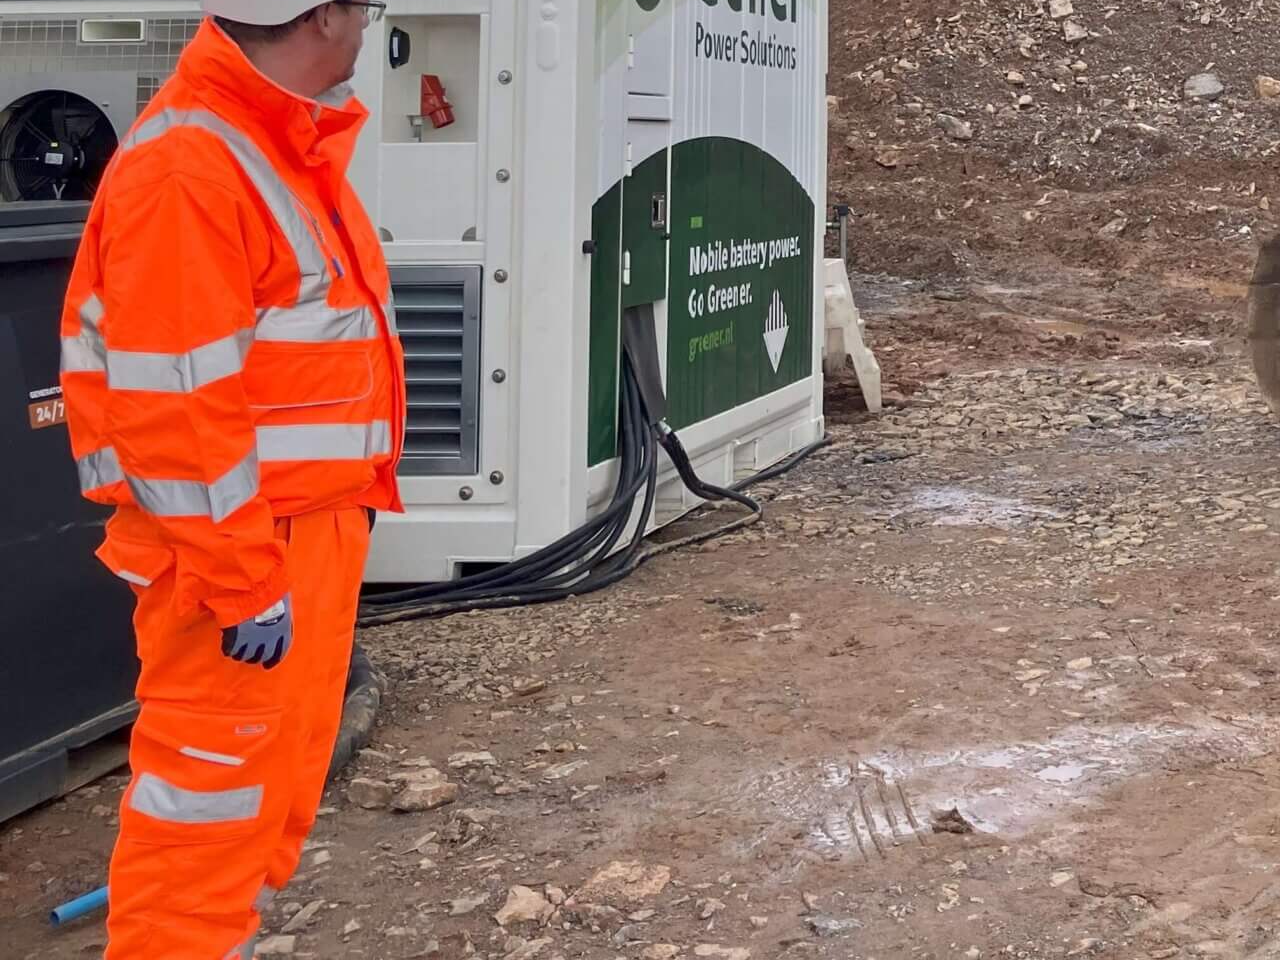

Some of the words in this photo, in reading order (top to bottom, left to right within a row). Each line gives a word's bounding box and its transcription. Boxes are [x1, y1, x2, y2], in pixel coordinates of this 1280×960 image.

[695, 21, 739, 63] Power
[740, 29, 797, 71] Solutions
[730, 238, 768, 270] battery
[768, 235, 801, 267] power.
[688, 288, 705, 319] Go
[707, 281, 753, 314] Greener.
[688, 320, 734, 363] greener.nl
